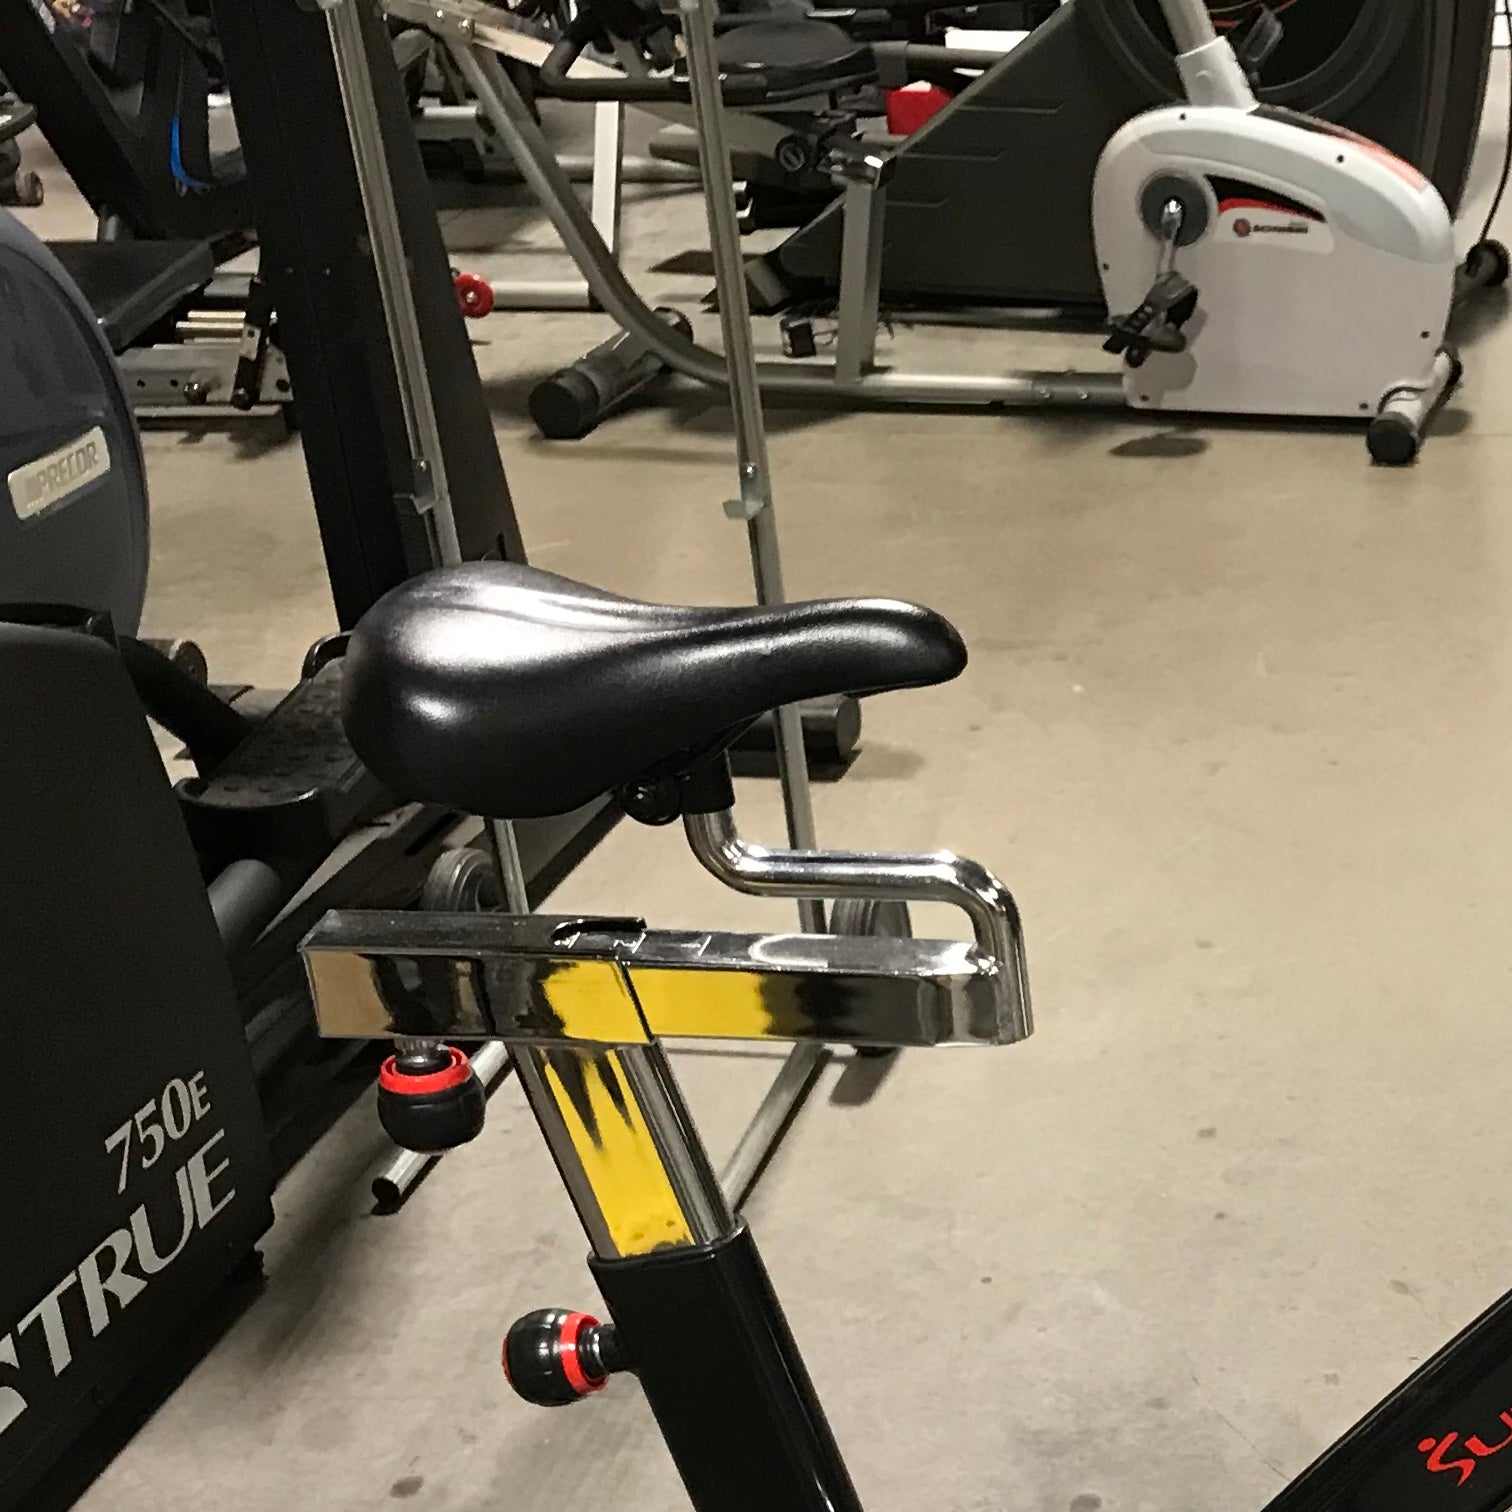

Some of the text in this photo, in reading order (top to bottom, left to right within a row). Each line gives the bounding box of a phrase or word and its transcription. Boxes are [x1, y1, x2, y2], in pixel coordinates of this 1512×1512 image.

[36, 441, 98, 492] PRECOR
[104, 1070, 211, 1194] 750E
[17, 1128, 236, 1377] TRUE
